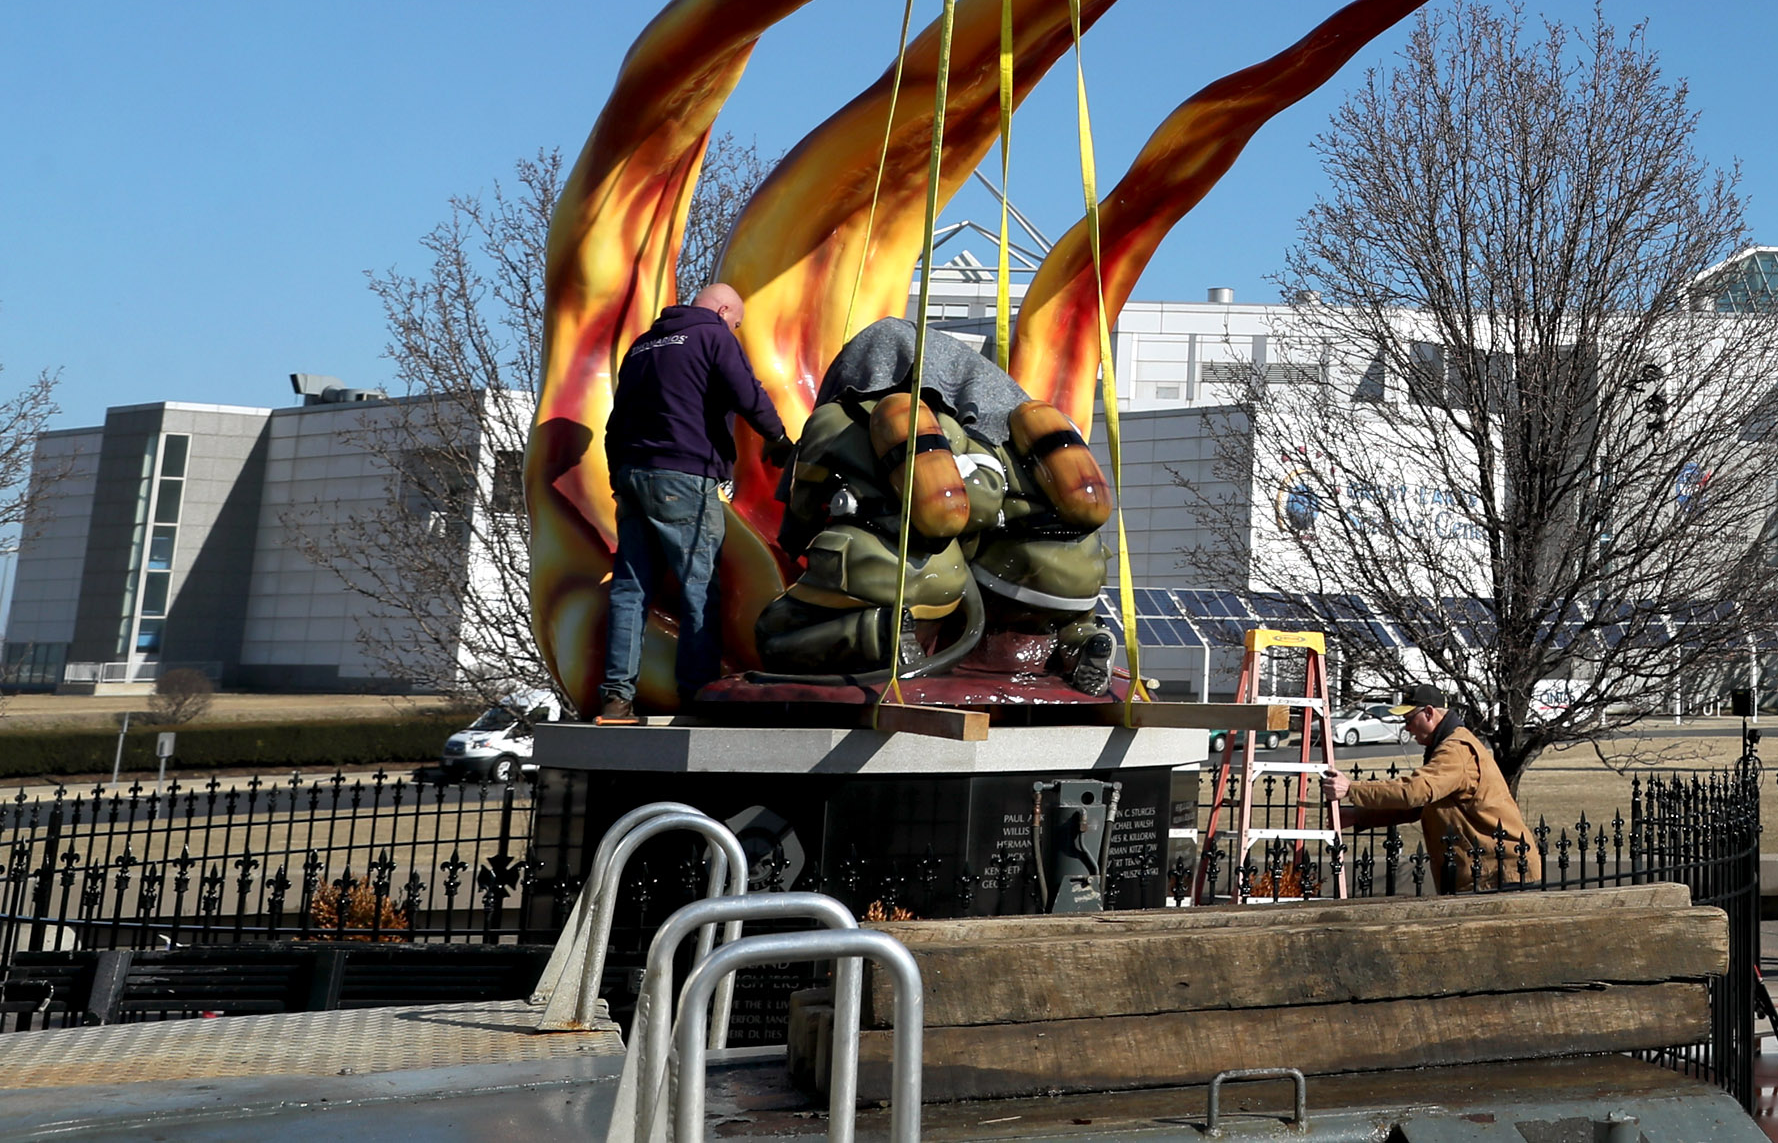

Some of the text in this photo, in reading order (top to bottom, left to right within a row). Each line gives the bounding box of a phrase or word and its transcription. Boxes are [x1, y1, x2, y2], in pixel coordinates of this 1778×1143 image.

[1436, 511, 1488, 540] Cent
[1003, 814, 1025, 823] PAUL
[1112, 819, 1154, 831] ICHAEL WALSH
[1129, 831, 1157, 841] KILLORAN
[1129, 843, 1158, 854] KITZOW
[991, 852, 1025, 862] PARICK
[984, 865, 1021, 876] KENETH
